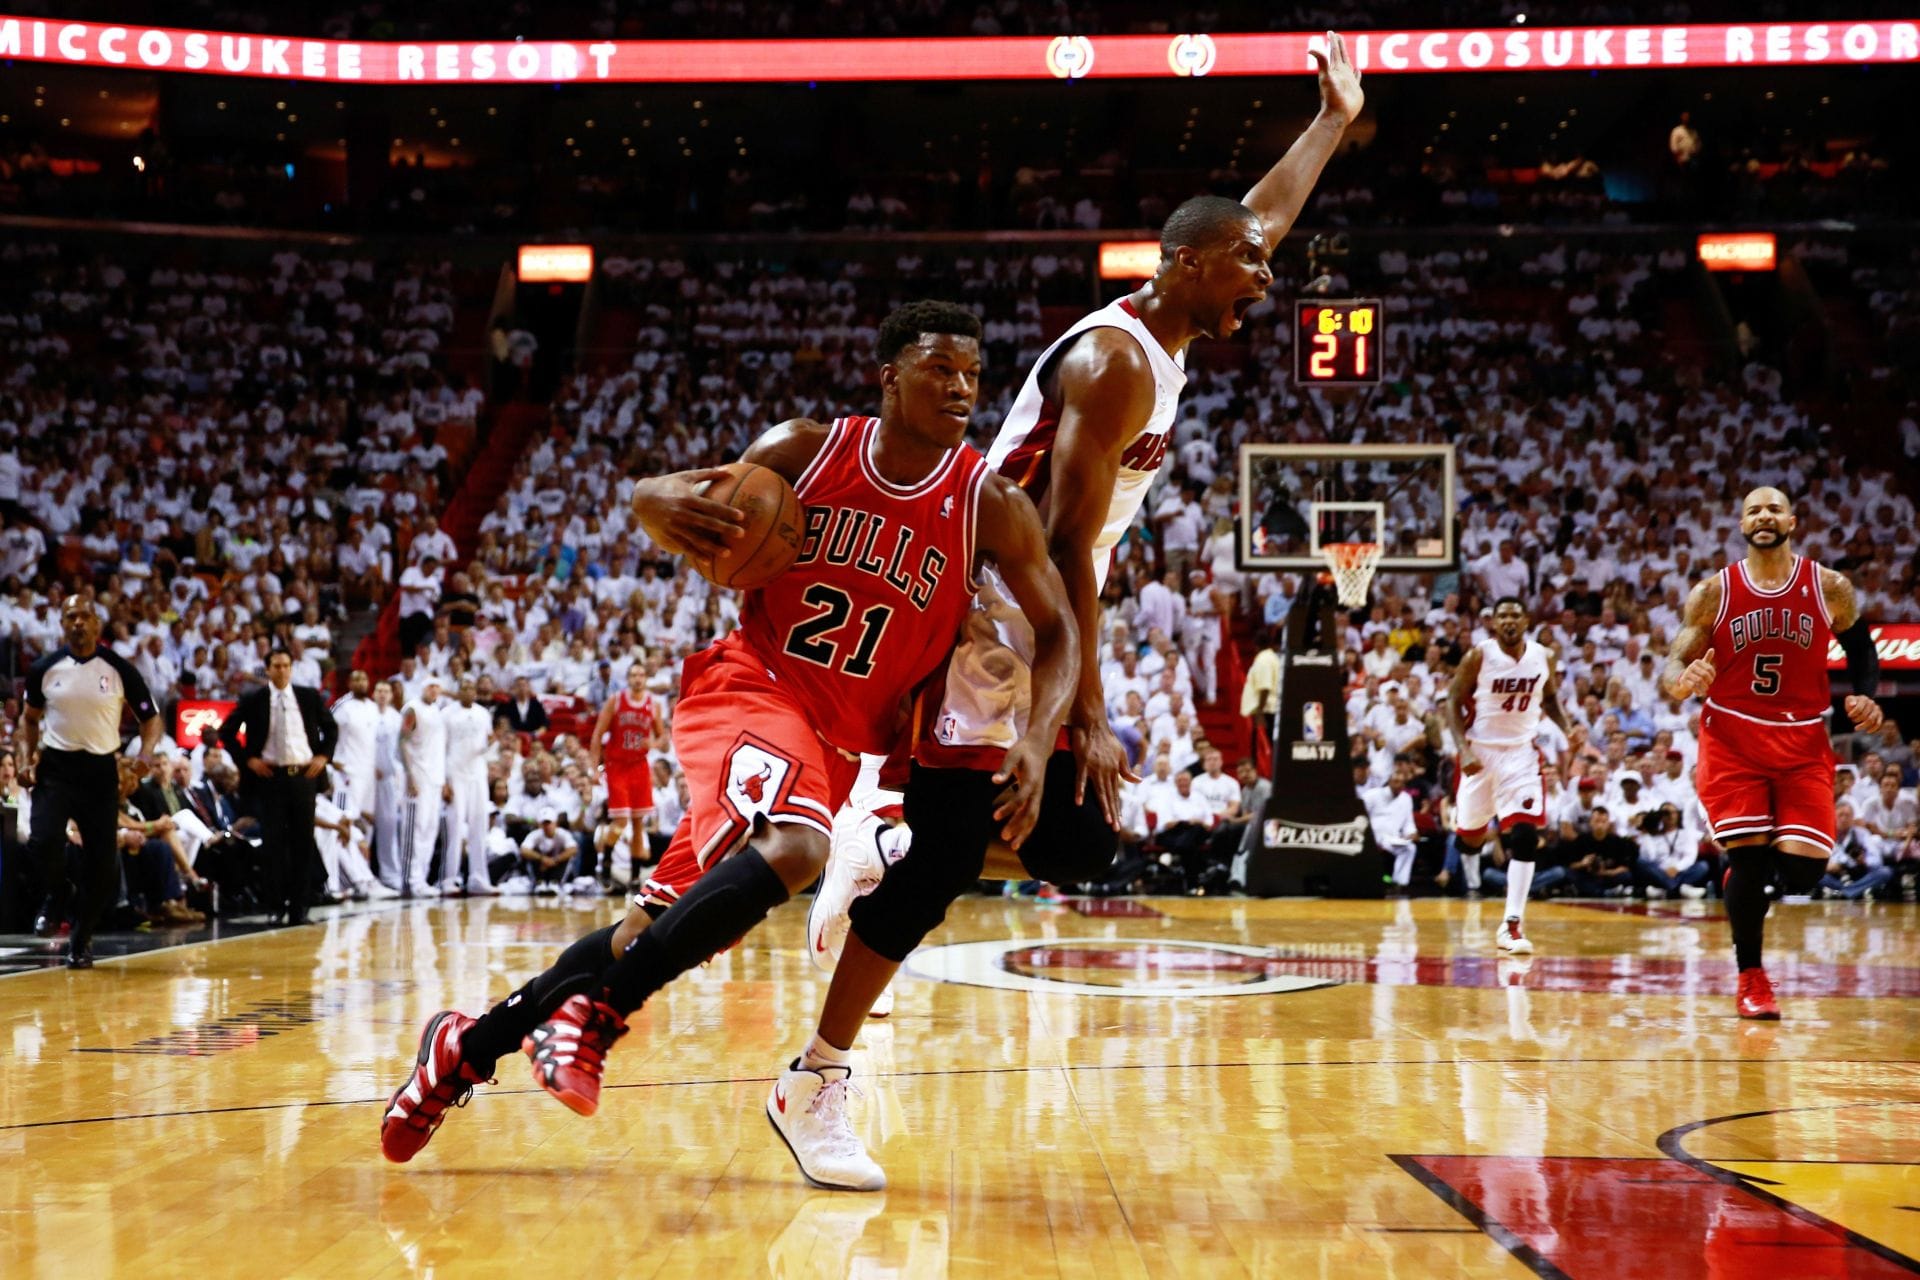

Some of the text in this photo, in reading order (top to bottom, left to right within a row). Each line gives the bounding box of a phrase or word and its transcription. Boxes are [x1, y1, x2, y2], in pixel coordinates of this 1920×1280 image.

[397, 42, 617, 80] RESORT
[1725, 23, 1919, 63] RESOR
[1318, 307, 1373, 335] 6:10
[1310, 333, 1366, 378] 21
[794, 505, 948, 612] BULLS
[783, 582, 894, 679] 21
[1730, 607, 1814, 654] BULLS
[1491, 674, 1541, 694] HEAT
[1751, 654, 1783, 696] 5
[1501, 694, 1531, 713] 40
[1277, 825, 1365, 845] PLAYOFFS
